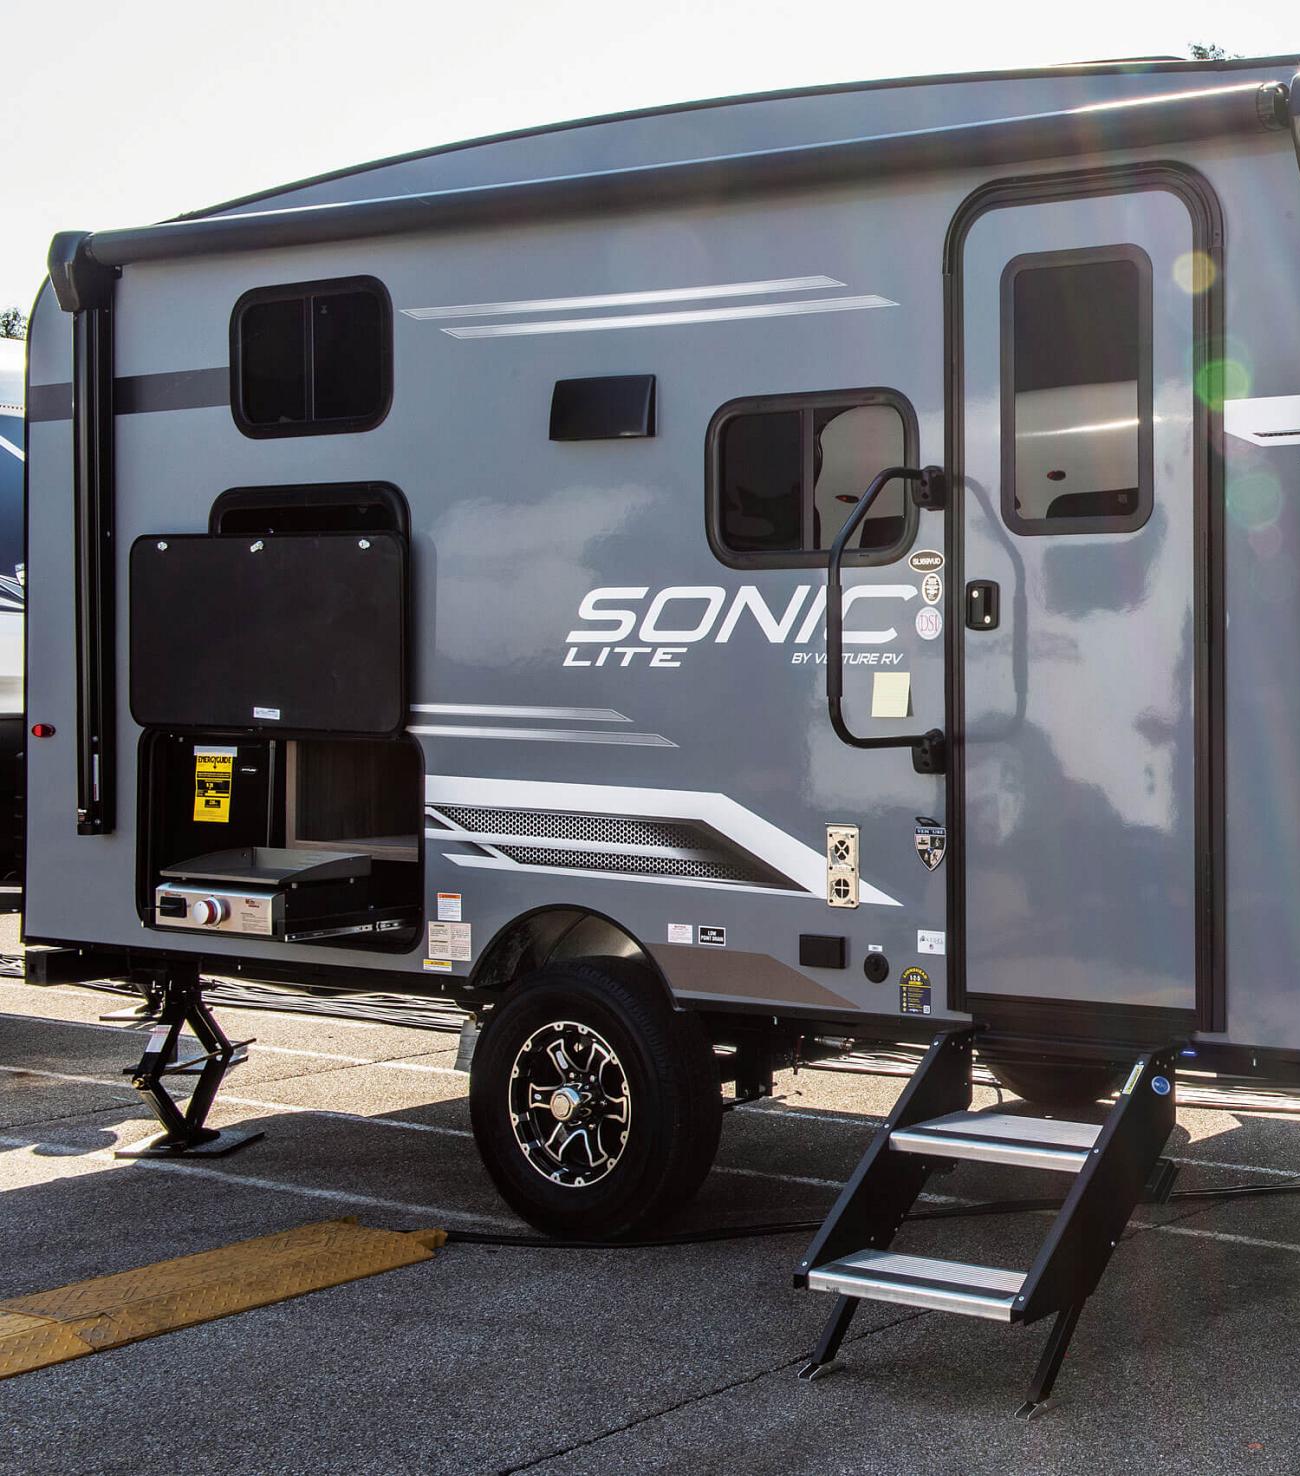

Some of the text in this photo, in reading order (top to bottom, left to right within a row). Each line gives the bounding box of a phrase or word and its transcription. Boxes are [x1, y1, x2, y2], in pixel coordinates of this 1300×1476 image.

[565, 585, 918, 643] SONIC
[562, 646, 688, 667] LITE
[791, 652, 904, 665] BY VTURE RV
